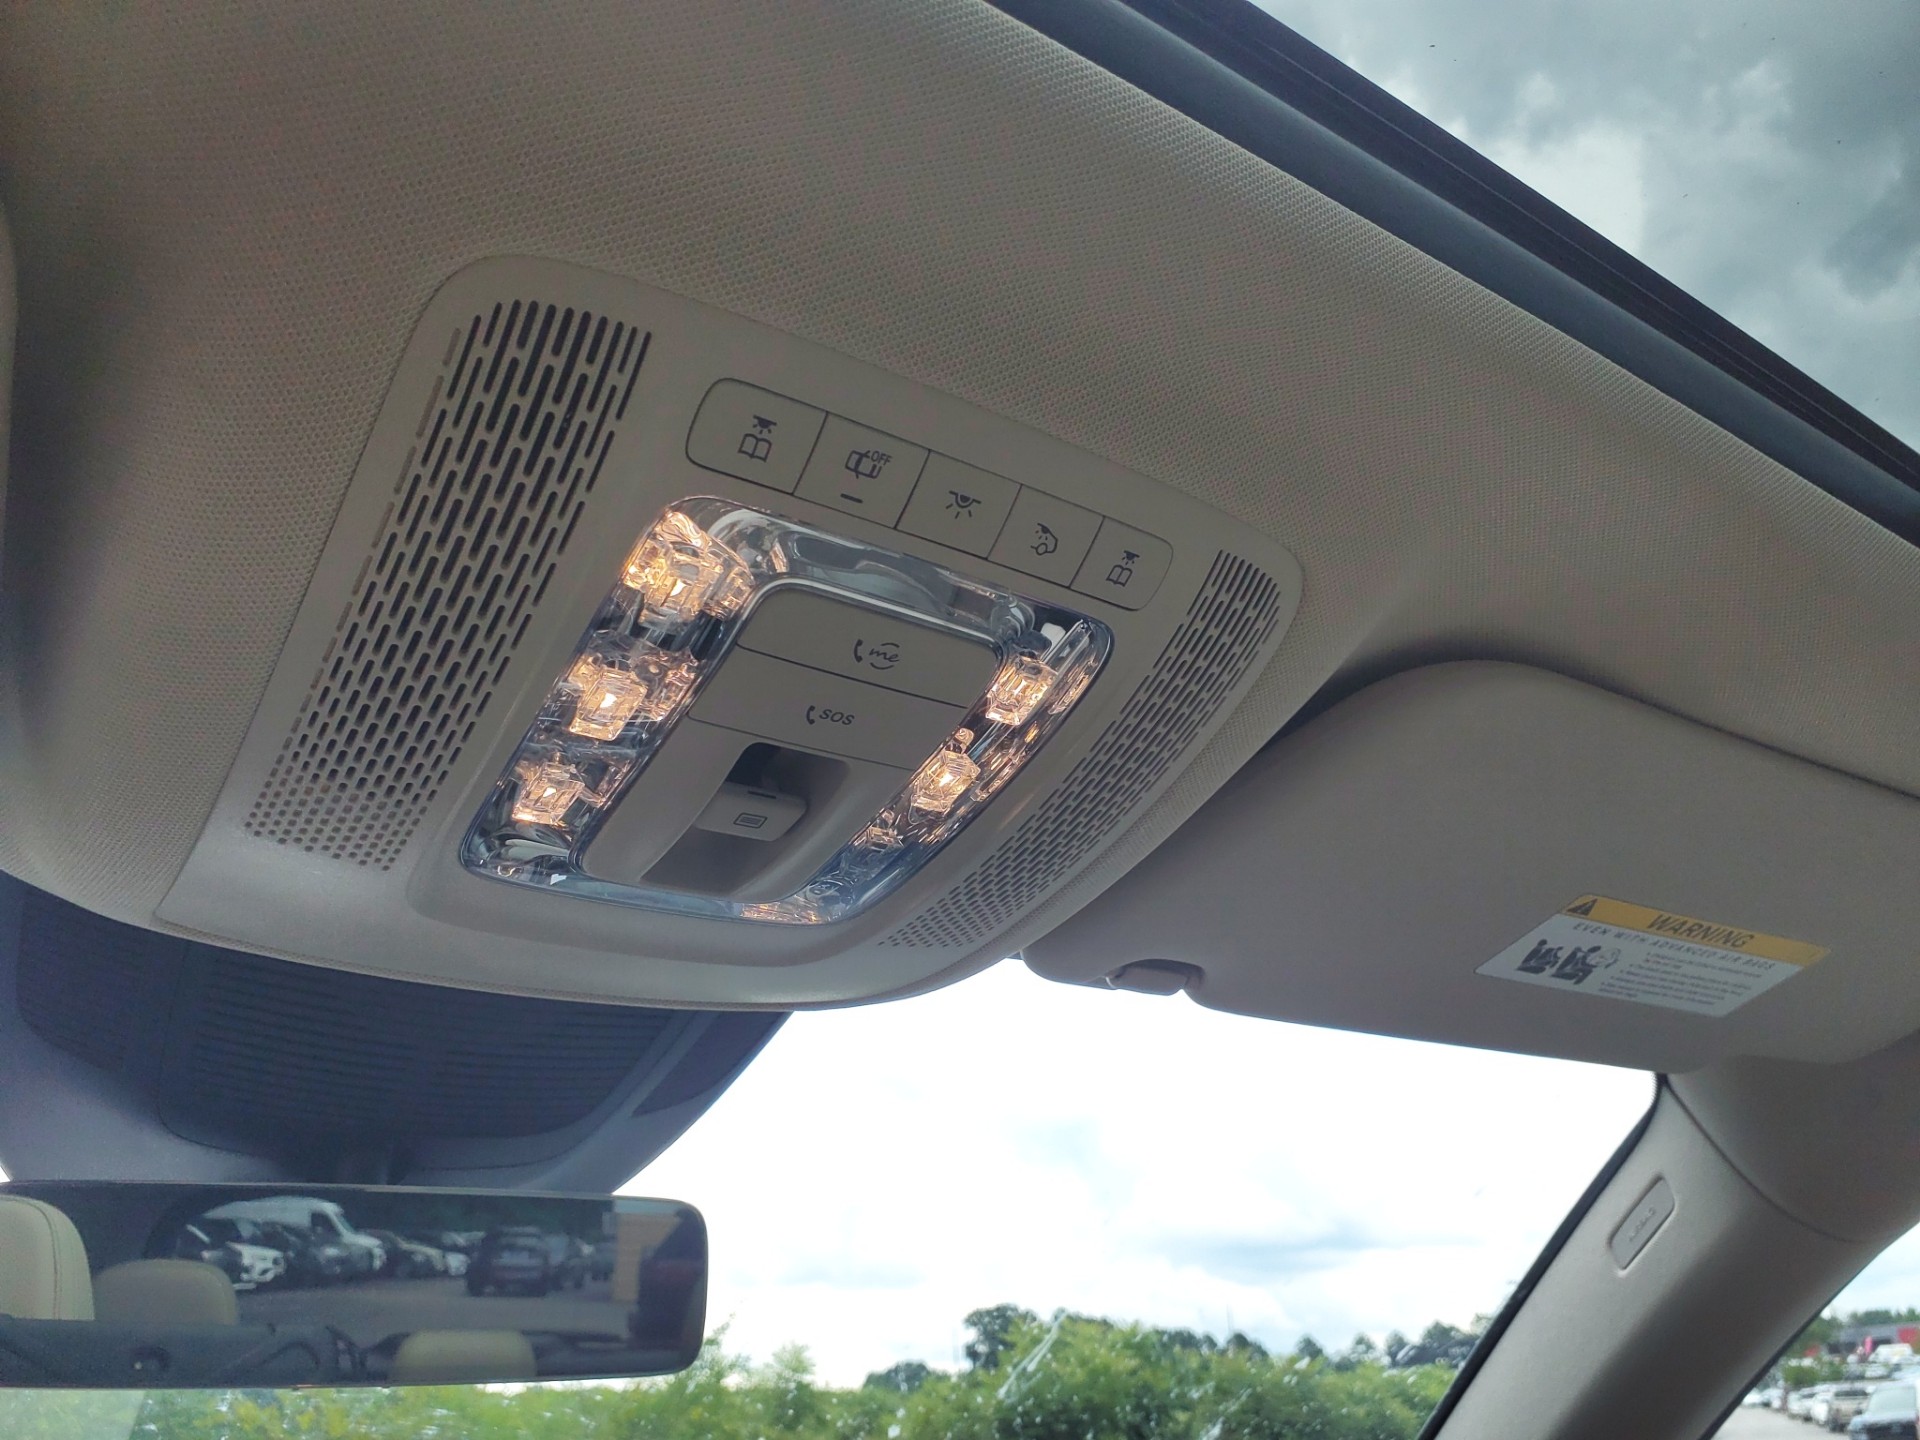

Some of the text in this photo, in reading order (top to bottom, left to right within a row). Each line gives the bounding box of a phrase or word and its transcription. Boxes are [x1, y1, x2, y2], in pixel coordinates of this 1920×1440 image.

[870, 450, 893, 466] OFF
[819, 709, 855, 726] SOS
[1646, 913, 1755, 949] WARNING
